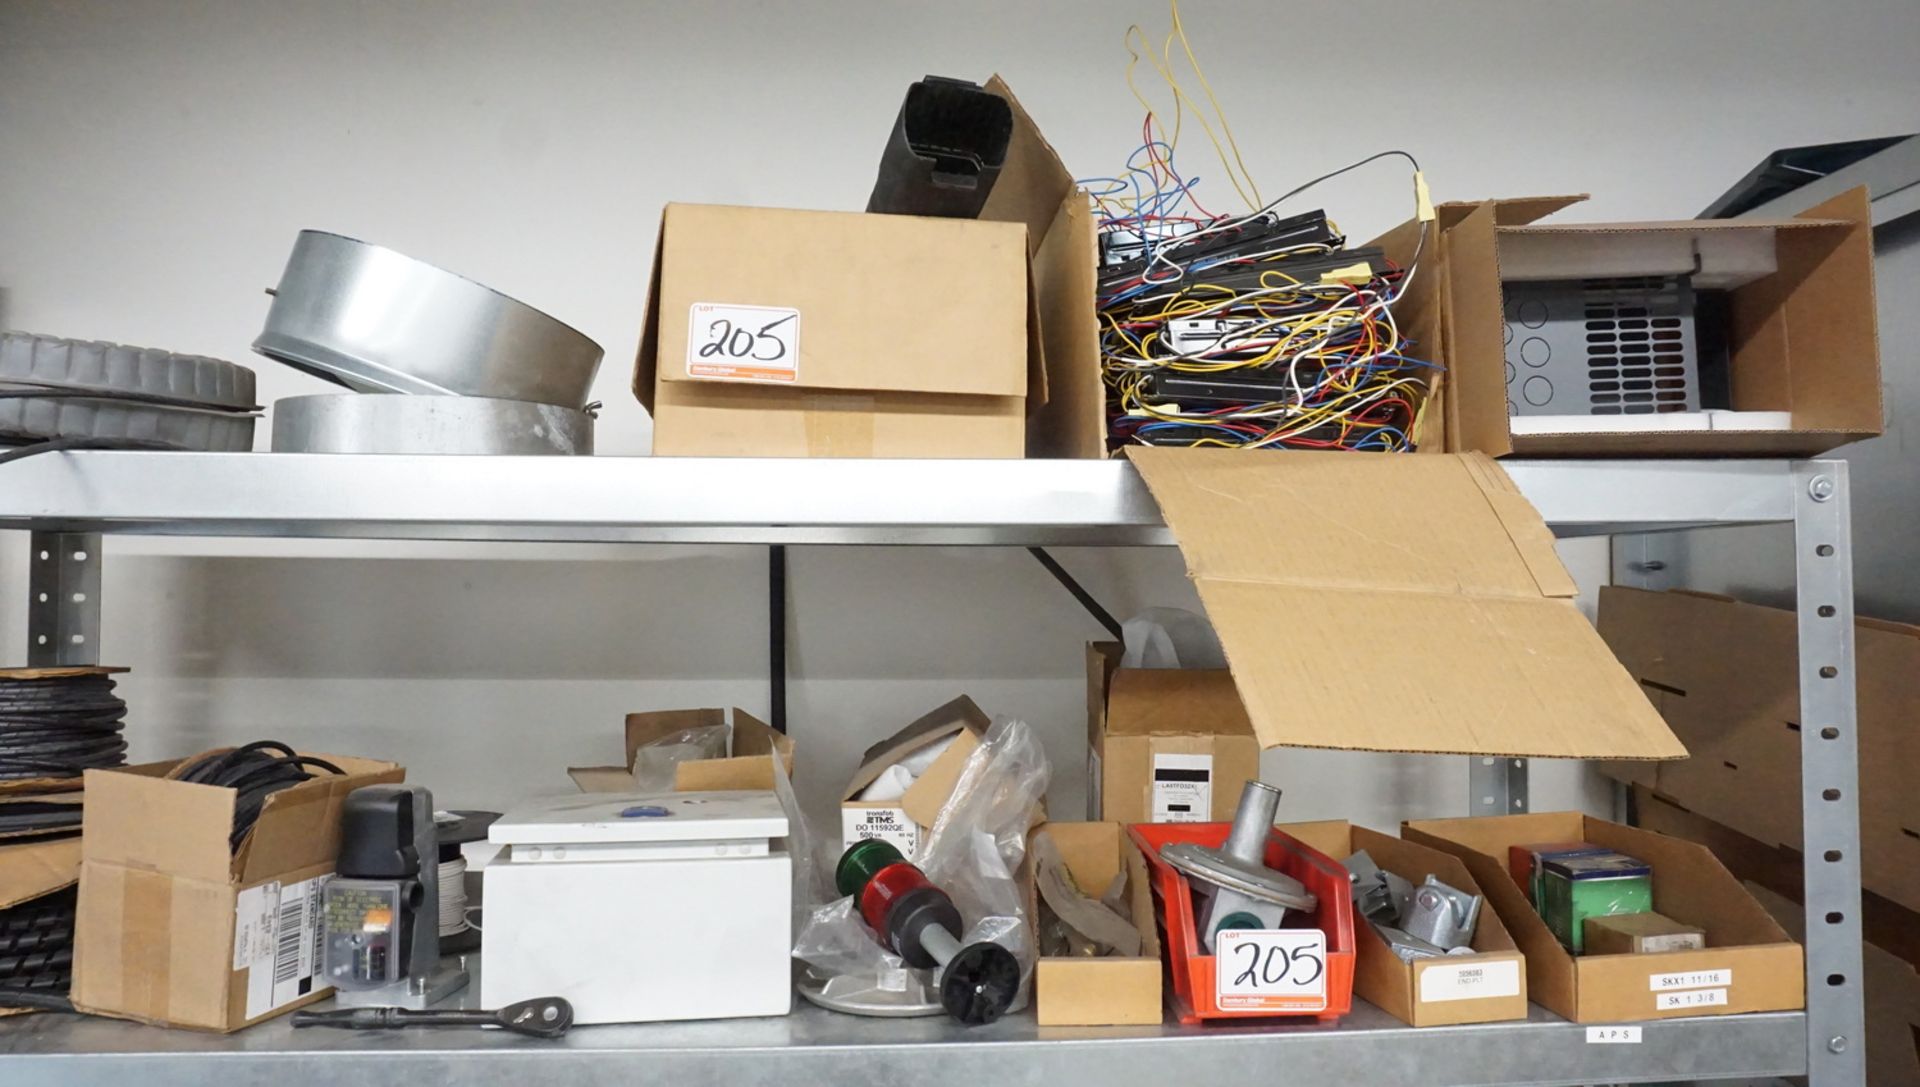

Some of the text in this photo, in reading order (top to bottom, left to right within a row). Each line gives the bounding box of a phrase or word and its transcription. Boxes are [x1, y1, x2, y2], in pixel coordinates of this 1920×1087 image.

[699, 314, 798, 361] 205
[1233, 942, 1322, 987] 205
[1662, 973, 1720, 986] SKX1 11/16
[1668, 996, 1680, 1005] SK
[1698, 992, 1715, 1002] 3/8
